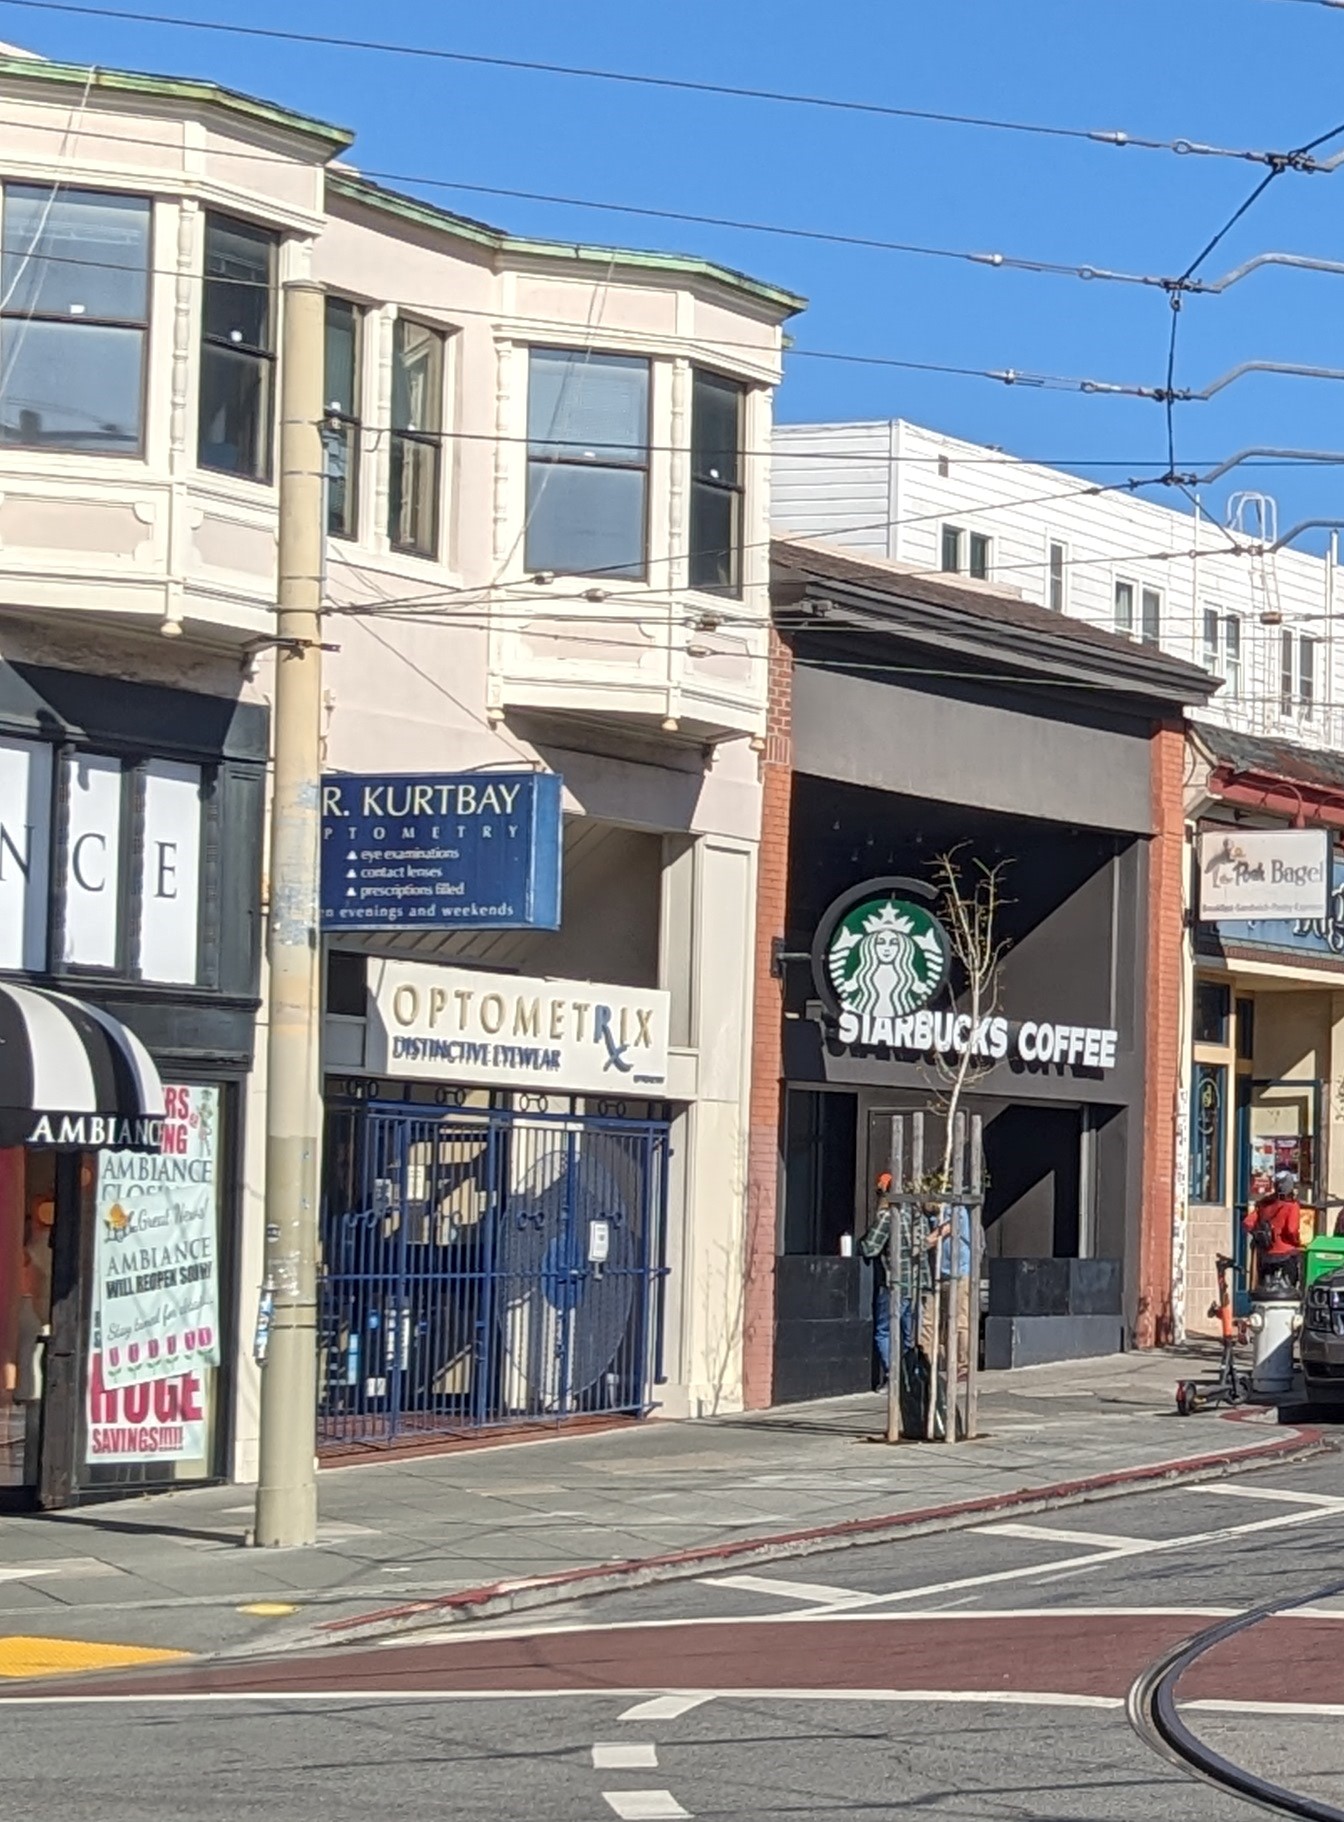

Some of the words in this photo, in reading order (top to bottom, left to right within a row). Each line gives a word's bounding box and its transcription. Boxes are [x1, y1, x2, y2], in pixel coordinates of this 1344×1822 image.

[321, 786, 350, 816] R.
[363, 783, 521, 816] KURTBAY
[323, 825, 519, 841] PTOMETRY
[361, 851, 382, 863] eye
[384, 847, 460, 860] examinations
[361, 865, 405, 878] contact
[407, 864, 443, 877] lenses
[1270, 859, 1325, 886] Bagel
[360, 883, 433, 899] prescriptions
[435, 882, 465, 895] filled
[340, 903, 404, 921] evenings
[408, 902, 437, 917] and
[441, 901, 514, 917] weekends
[393, 984, 654, 1073] OPTOMETRIX
[838, 1010, 1008, 1060] STARBUCKS
[1017, 1022, 1118, 1068] COFFEE
[392, 1035, 492, 1068] DISTINCTIVE
[102, 1157, 213, 1184] AMBIANCE
[107, 1236, 212, 1277] AMBIANCE
[106, 1277, 135, 1300] WILL
[91, 1353, 204, 1424] HUGE
